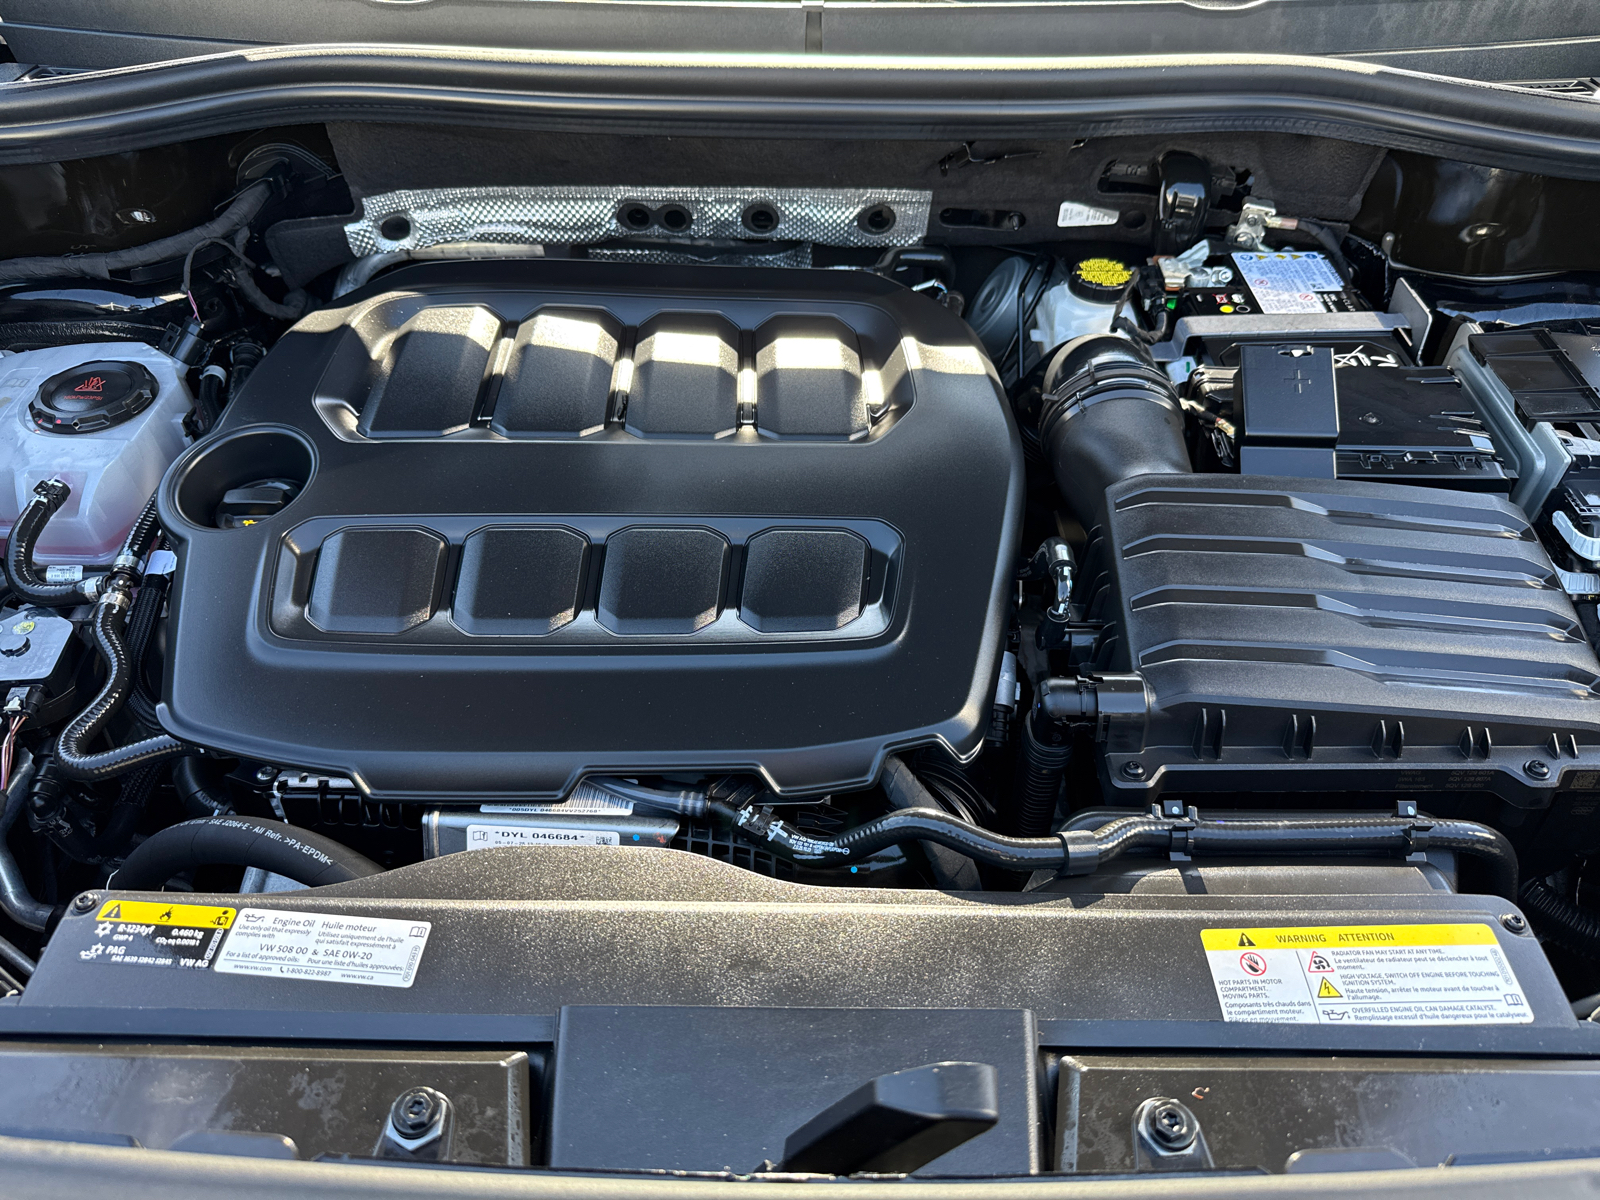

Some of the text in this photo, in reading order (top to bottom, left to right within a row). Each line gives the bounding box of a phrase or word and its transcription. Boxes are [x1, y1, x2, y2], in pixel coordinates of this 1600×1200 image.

[253, 826, 265, 835] All
[265, 828, 282, 842] Refr.
[272, 917, 316, 928] Engine Oil
[321, 920, 377, 933] Huile moteur
[117, 923, 204, 940] R-1234yf 0.460 kg
[235, 930, 261, 938] complies
[284, 928, 312, 936] expressly
[318, 930, 340, 938] Utilisez
[340, 934, 376, 942] uniquement
[1275, 932, 1395, 943] WARNING ATTENTION
[105, 944, 126, 955] PAG
[350, 941, 390, 949] expressément
[241, 951, 252, 959] list
[258, 954, 286, 962] approved
[259, 943, 277, 952] VW
[276, 945, 294, 954] 508
[295, 947, 309, 955] 00
[323, 948, 341, 957] SAE
[342, 950, 373, 960] 0W-20
[111, 954, 124, 962] SAE
[180, 957, 209, 968] VW AG
[233, 964, 332, 977] www.vw.com 1-800-822-8987
[1224, 1001, 1262, 1009] Composants
[1234, 1008, 1279, 1016] compartiment
[1354, 1014, 1393, 1022] Remplissage
[1440, 1013, 1473, 1021] dangereux
